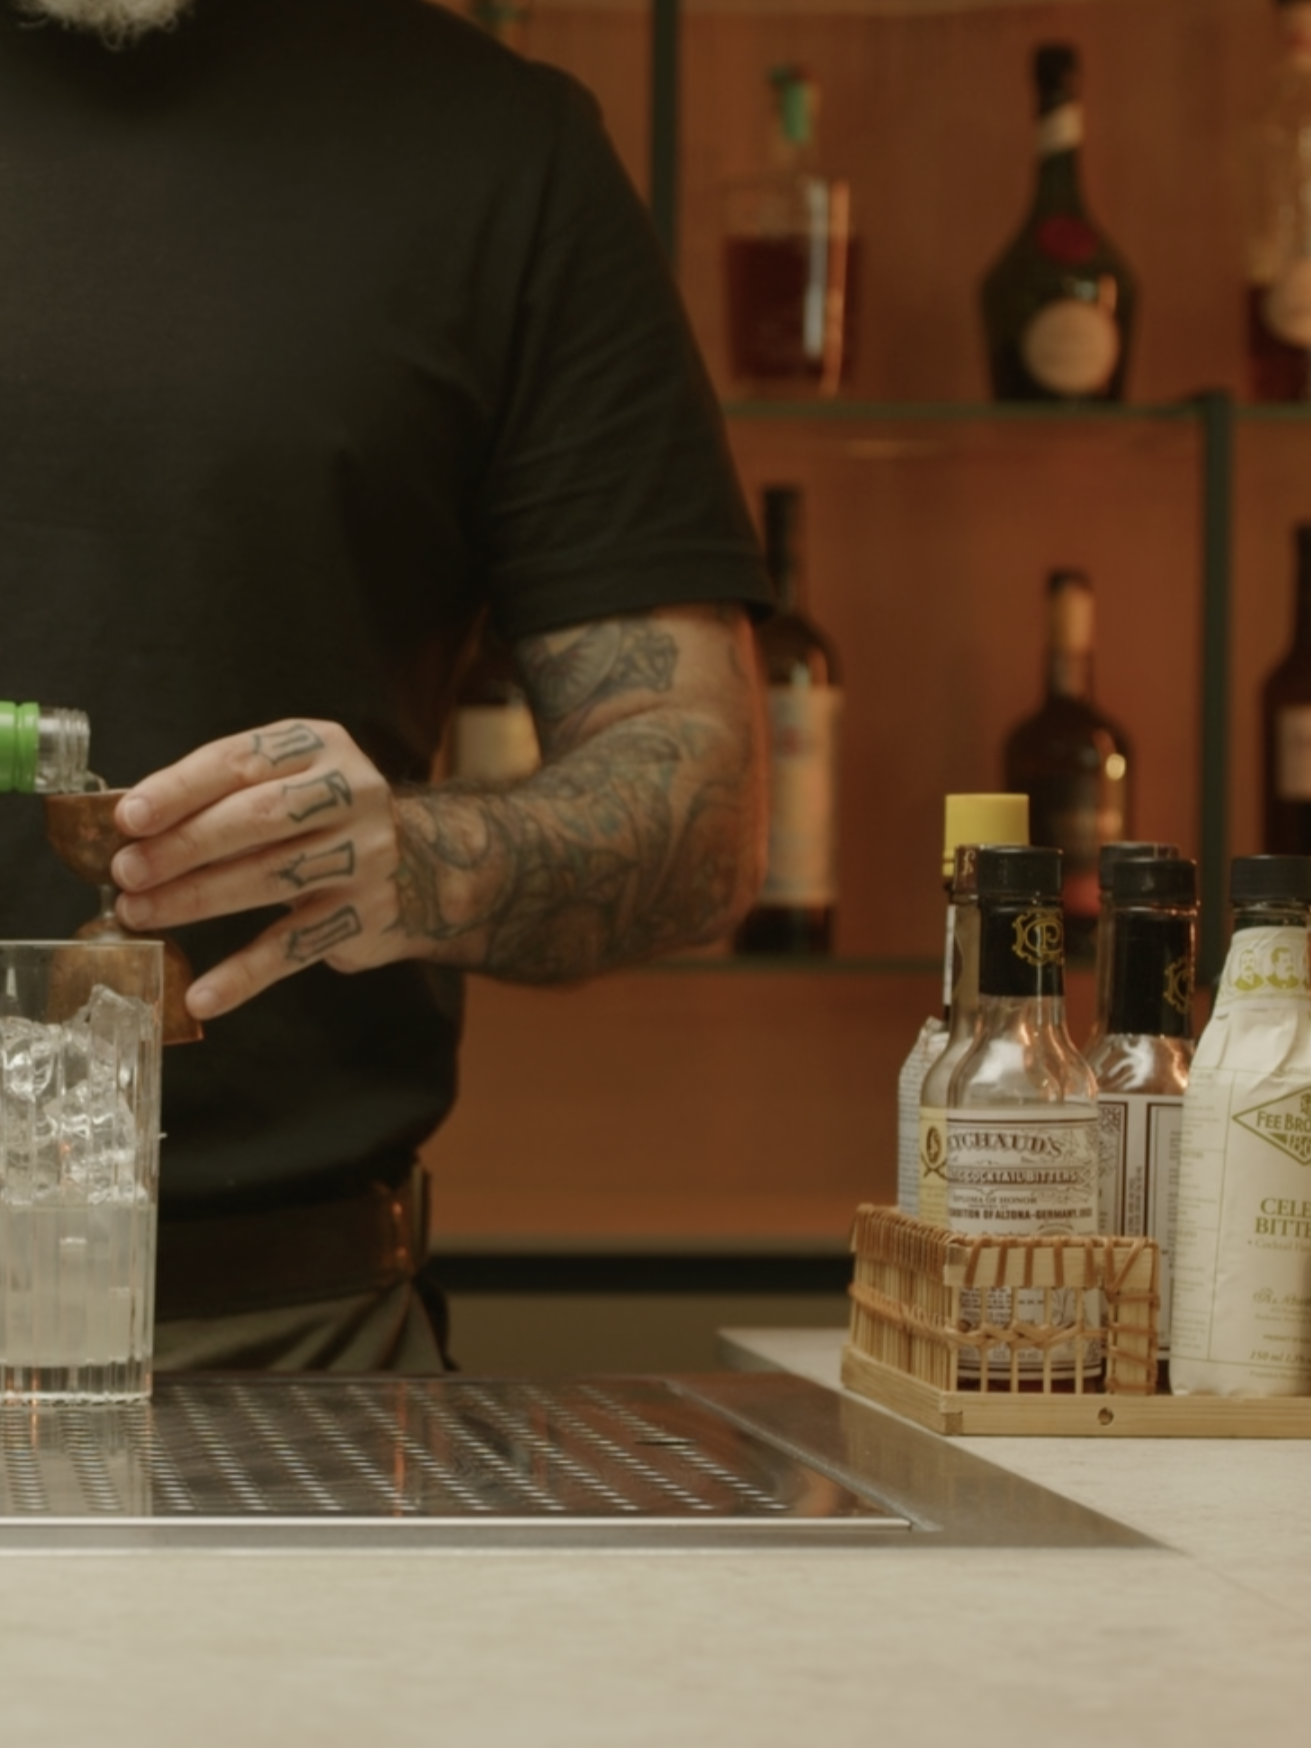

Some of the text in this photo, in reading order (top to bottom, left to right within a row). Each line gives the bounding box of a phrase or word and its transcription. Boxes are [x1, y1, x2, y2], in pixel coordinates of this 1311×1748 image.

[1256, 1110, 1282, 1129] FEE
[967, 1170, 1023, 1184] COCKTAIL
[1026, 1170, 1079, 1184] BITTERS
[999, 1196, 1038, 1205] HONOR
[983, 1208, 994, 1219] OF
